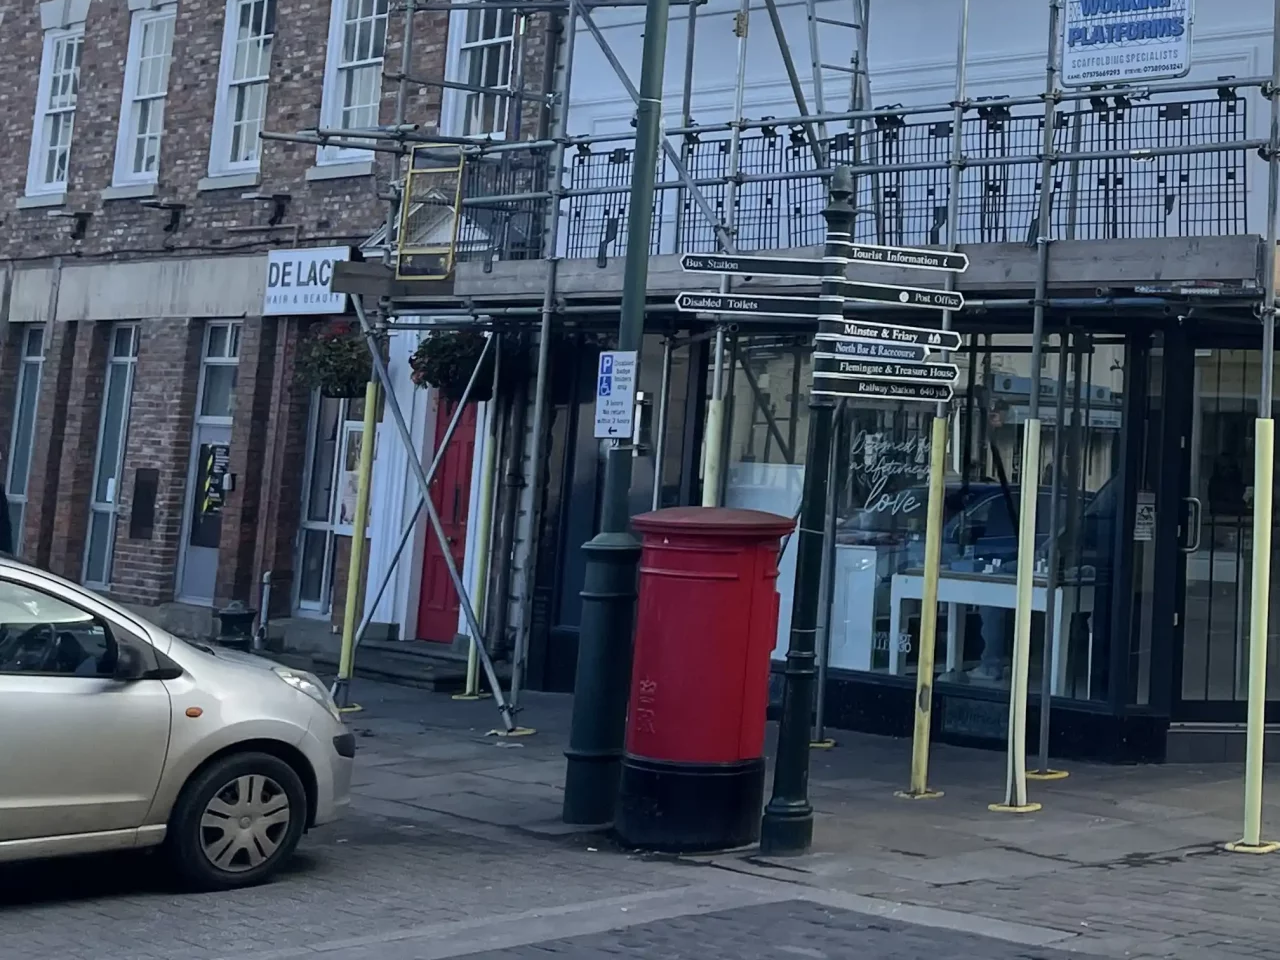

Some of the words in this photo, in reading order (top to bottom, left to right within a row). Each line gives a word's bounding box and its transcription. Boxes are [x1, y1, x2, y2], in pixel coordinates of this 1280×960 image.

[1067, 16, 1185, 47] PLATFORMS
[1071, 54, 1124, 69] SCAFFOLDING
[1125, 49, 1179, 64] SPECIALISTS
[685, 258, 703, 268] Bus
[706, 259, 739, 270] Station
[852, 247, 883, 261] Tourist
[886, 250, 939, 266] Information
[268, 261, 292, 288] DE
[296, 259, 334, 287] LAC
[266, 294, 288, 305] HAIR
[293, 295, 298, 304] &
[303, 293, 340, 304] BEAUTY
[682, 296, 722, 308] Disabled
[726, 299, 758, 310] Toilets
[914, 292, 931, 303] Post
[934, 294, 959, 306] Office
[844, 324, 879, 337] Minster
[881, 328, 889, 338] &
[892, 330, 918, 343] Friary
[835, 341, 855, 353] North
[856, 343, 869, 354] Bar
[869, 344, 877, 354] &
[877, 346, 916, 359] Racecourse
[602, 356, 613, 373] P
[839, 361, 883, 375] Flemingate
[885, 364, 892, 374] &
[894, 365, 928, 376] Treasure
[929, 367, 954, 378] House
[858, 382, 888, 395] Railway
[890, 384, 915, 395] Station
[919, 386, 934, 396] 640
[935, 387, 948, 398] yds
[864, 475, 921, 516] love
